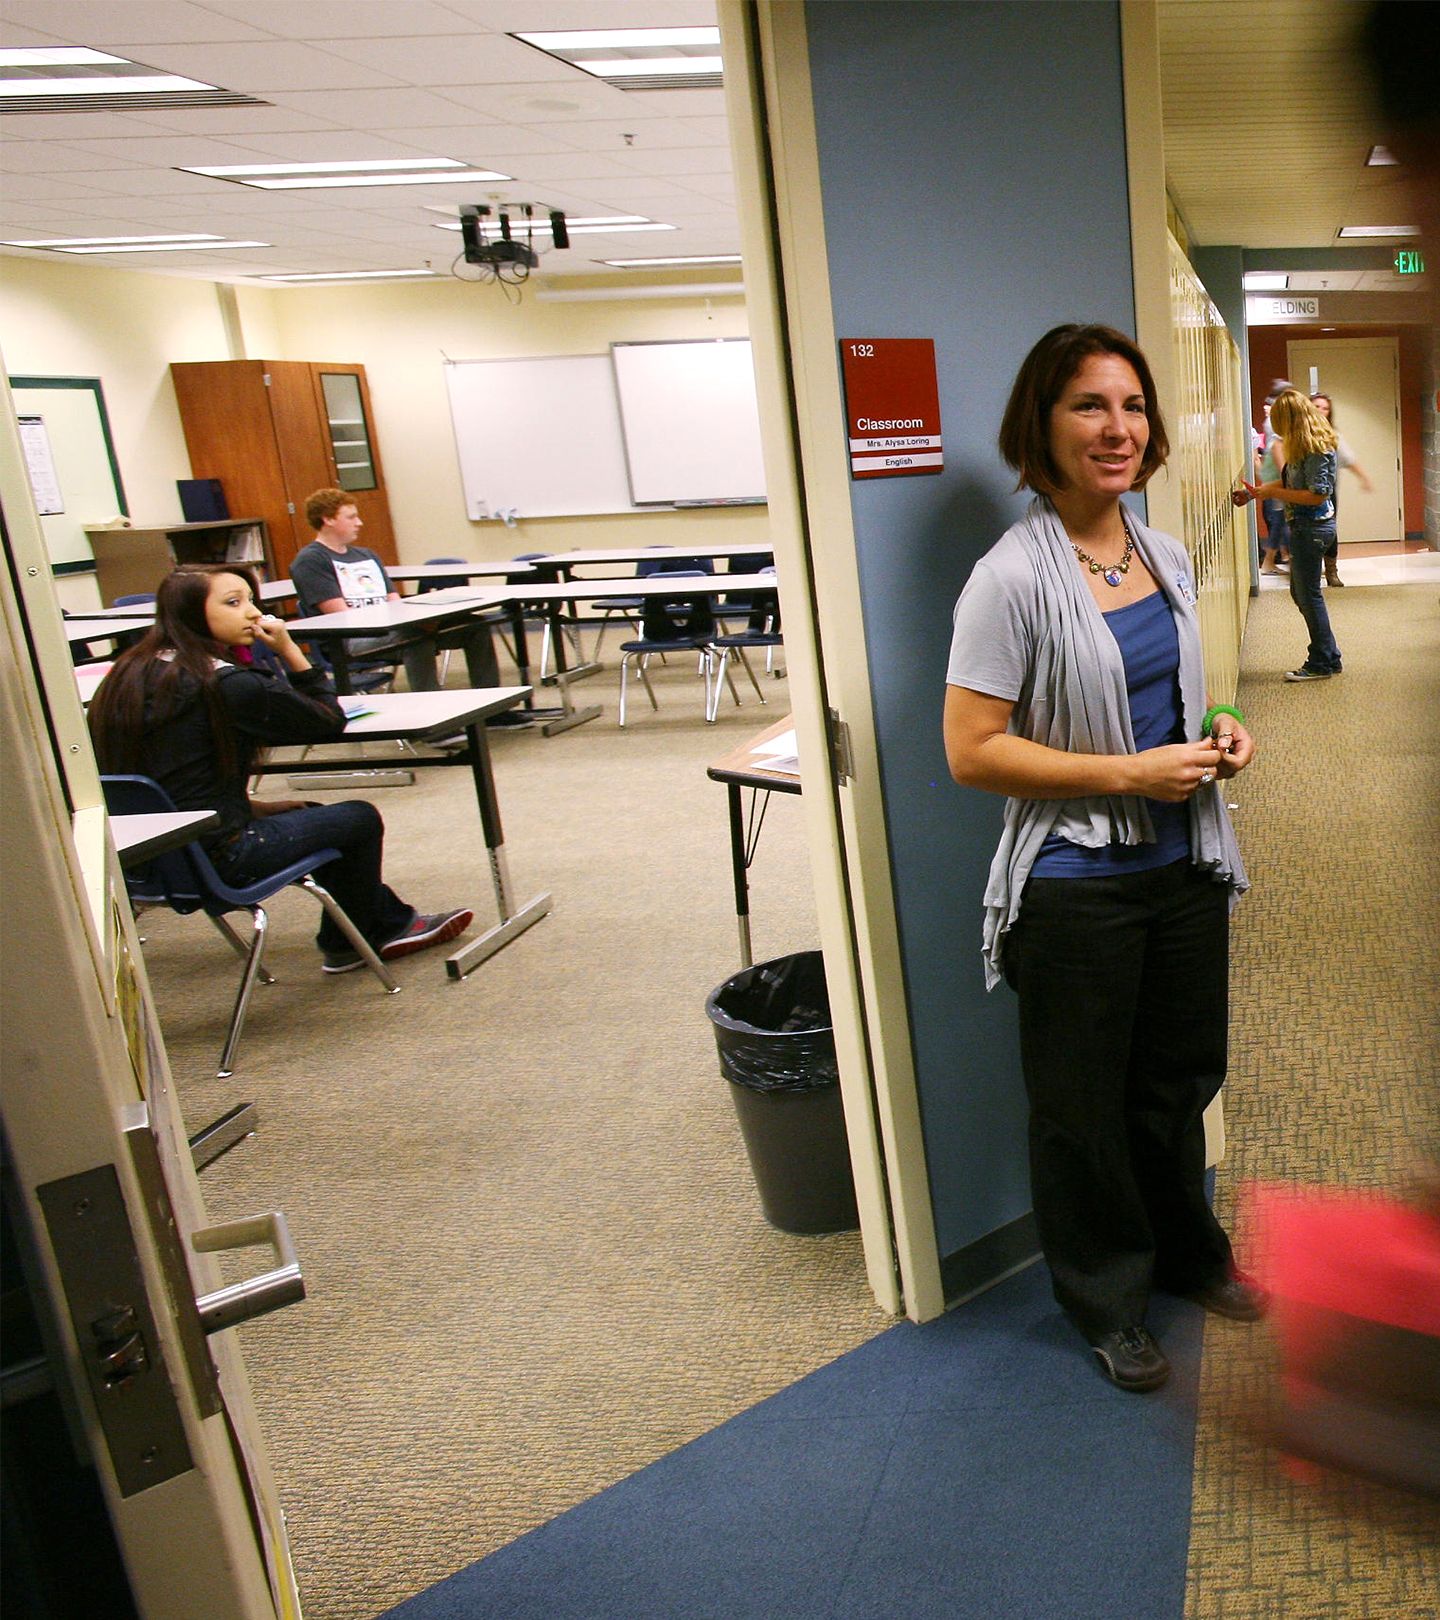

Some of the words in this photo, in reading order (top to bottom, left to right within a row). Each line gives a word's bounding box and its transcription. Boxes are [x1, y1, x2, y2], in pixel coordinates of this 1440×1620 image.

[1272, 301, 1316, 314] ELDING
[850, 344, 874, 357] 132
[857, 418, 923, 431] Classroom
[867, 440, 883, 448] Mrs.
[885, 438, 905, 447] Alysa
[907, 437, 930, 446] Loring
[885, 458, 913, 467] English
